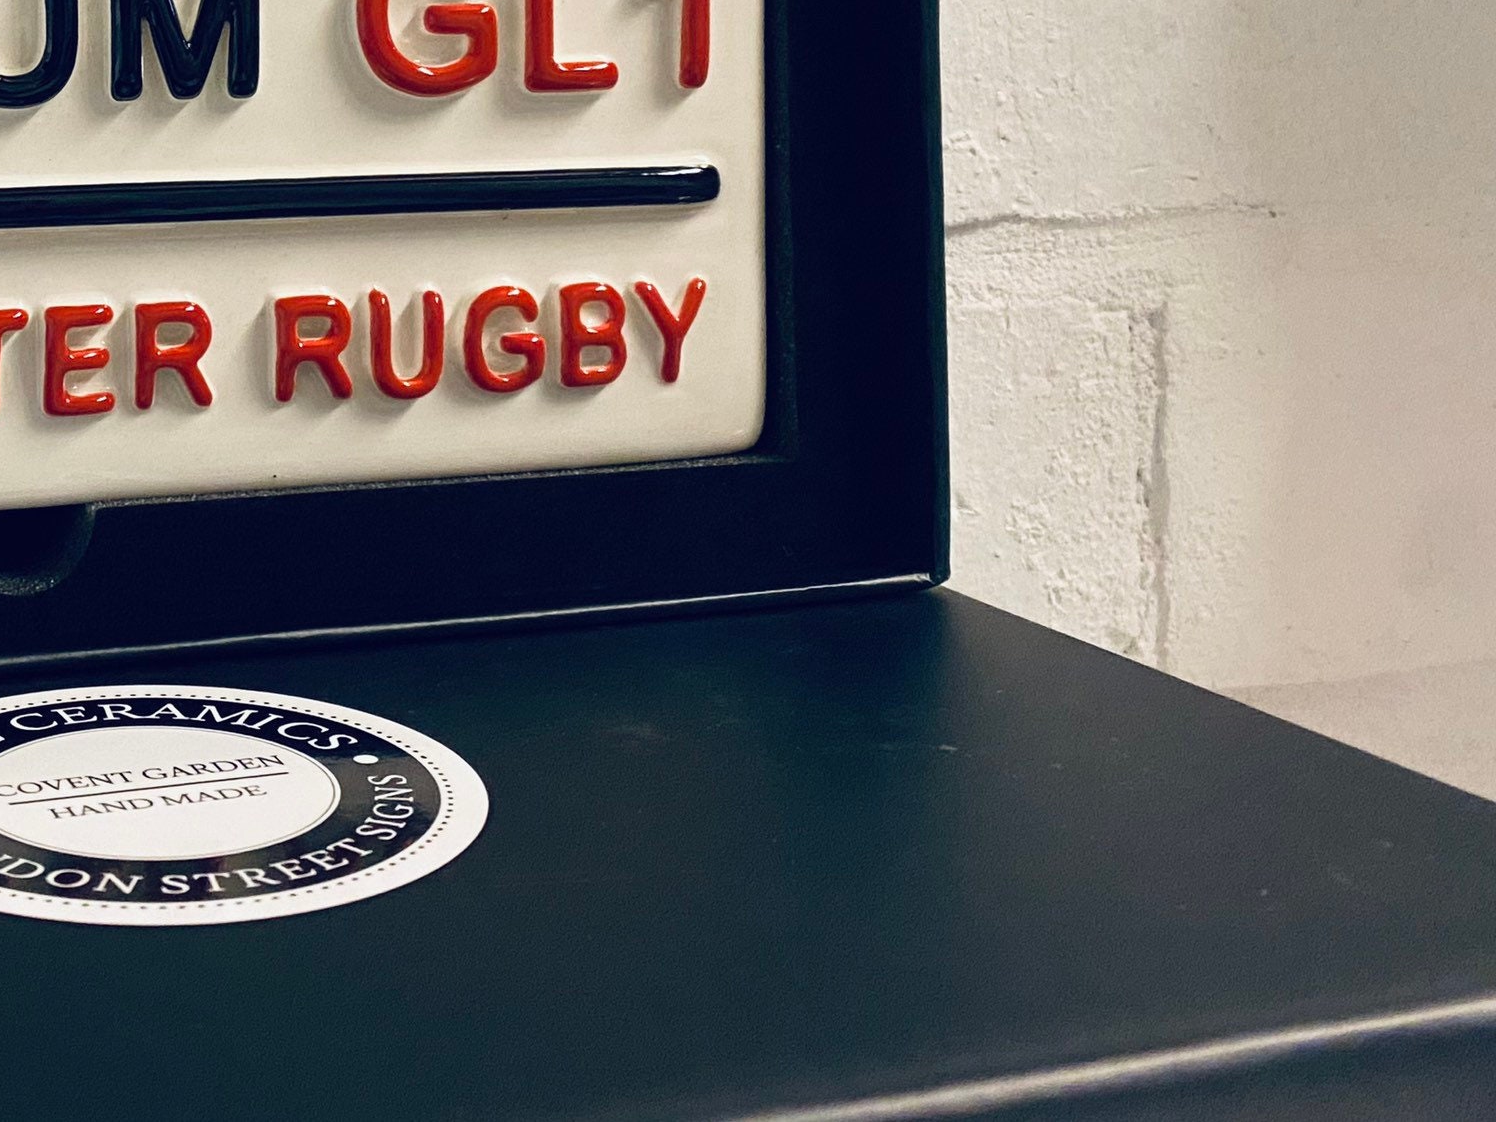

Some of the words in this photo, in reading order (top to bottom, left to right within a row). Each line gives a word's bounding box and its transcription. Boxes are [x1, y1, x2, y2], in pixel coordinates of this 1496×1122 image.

[273, 278, 707, 403] RUGBY
[9, 703, 359, 751] CERAMICS
[142, 755, 285, 780] GARDEN
[49, 797, 154, 820] HAND
[161, 784, 268, 807] MADE
[160, 838, 373, 895] STREET
[355, 774, 414, 841] SIGNS
